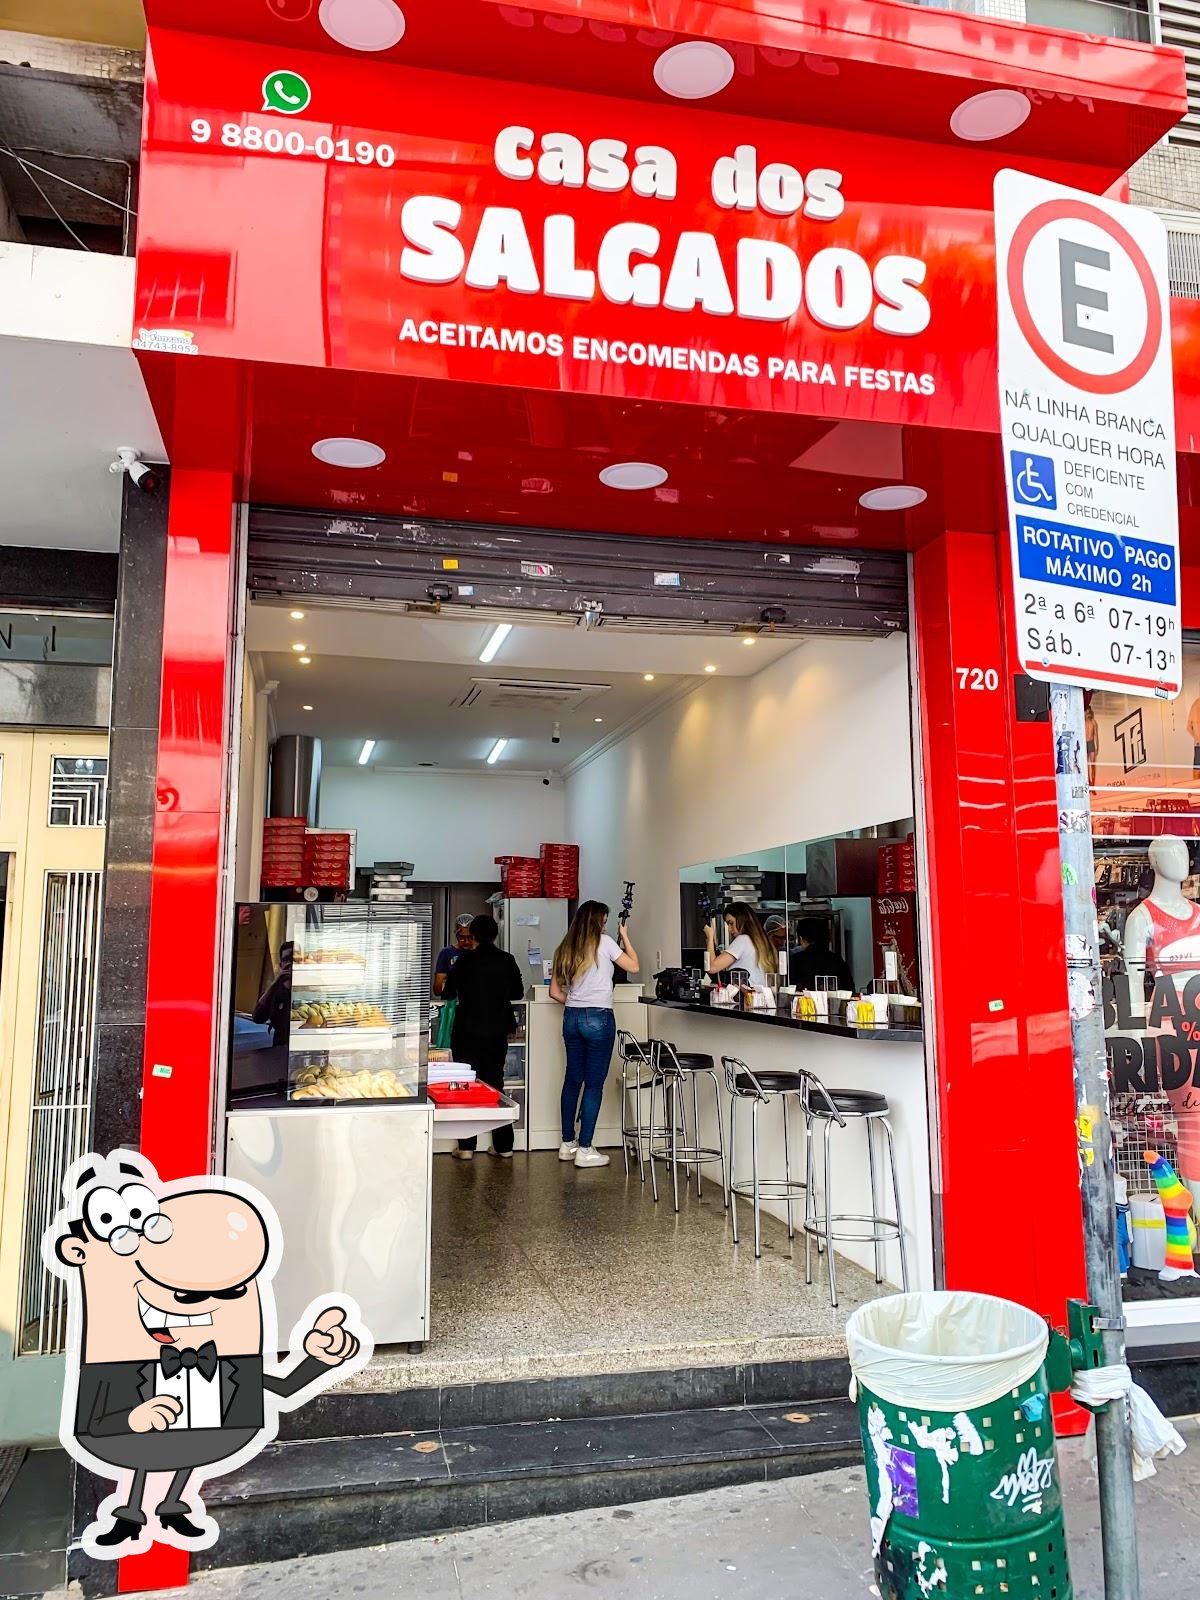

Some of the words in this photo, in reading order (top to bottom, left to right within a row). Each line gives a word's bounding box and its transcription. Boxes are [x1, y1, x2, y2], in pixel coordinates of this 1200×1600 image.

[190, 119, 211, 143] 9
[221, 123, 395, 168] 8800-0190
[494, 125, 678, 200] casa
[711, 144, 845, 221] dos
[400, 195, 931, 336] SALGADOS
[1058, 238, 1114, 355] E
[399, 318, 564, 358] ACEITAMOS
[572, 337, 760, 378] ENCOMENDAS
[768, 357, 836, 386] PARA
[845, 365, 936, 395] FESTAS
[1037, 396, 1090, 424] LINHA
[1095, 409, 1166, 440] BRANCA
[1012, 422, 1112, 458] QUALQUER
[1117, 444, 1166, 470] HORA
[1064, 460, 1145, 490] DEFICIENTE
[1065, 482, 1094, 499] COM
[1067, 502, 1140, 528] CREDENCIAL
[1023, 525, 1114, 559] ROTATIVO
[1124, 545, 1171, 571] PAGO
[1046, 555, 1122, 587] MÁXIMO
[1131, 573, 1152, 593] 2h
[1054, 603, 1065, 620] a
[1027, 627, 1081, 657] Sáb.
[955, 667, 999, 691] 720
